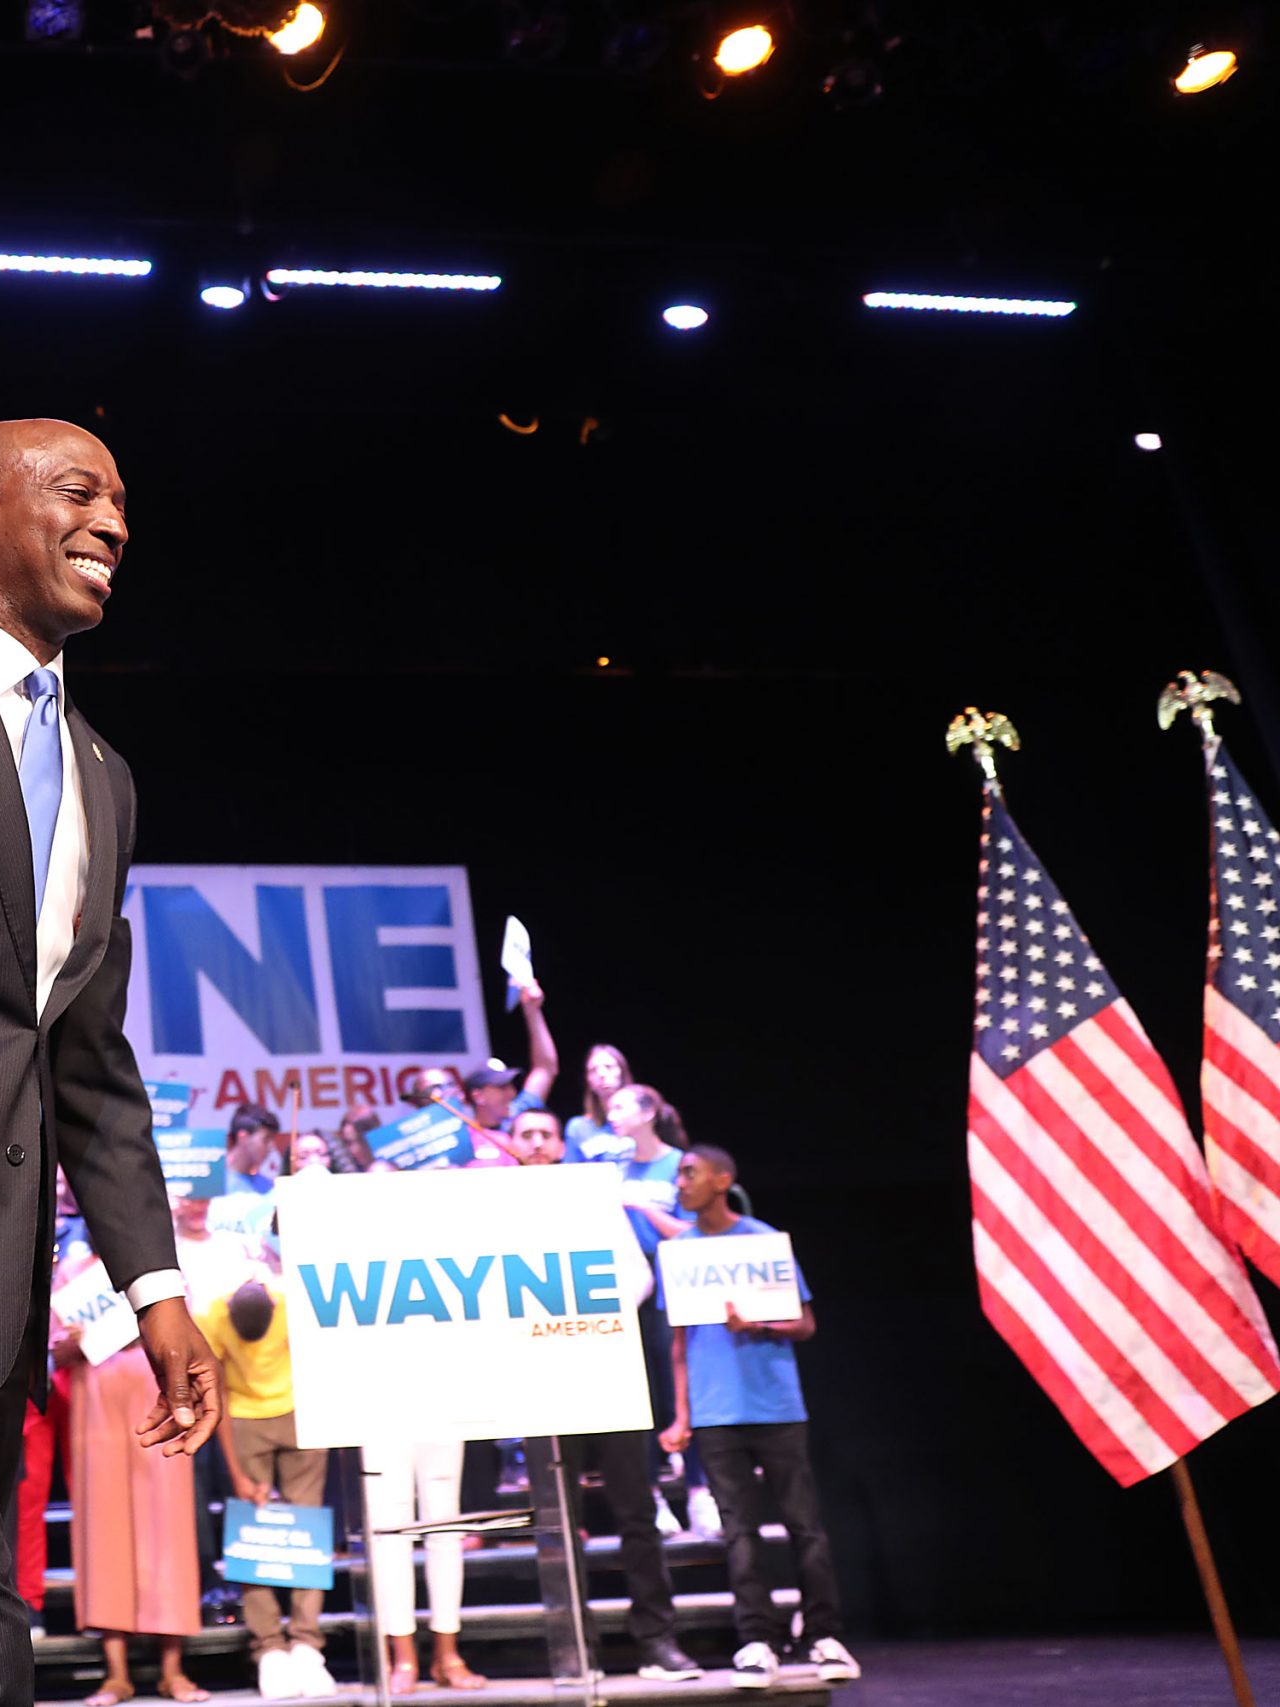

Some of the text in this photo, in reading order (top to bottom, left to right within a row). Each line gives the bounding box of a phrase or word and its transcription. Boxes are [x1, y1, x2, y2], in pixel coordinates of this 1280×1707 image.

[670, 1260, 793, 1288] WAYNE
[297, 1249, 622, 1328] WAYNE
[531, 1319, 624, 1338] AMERICA
